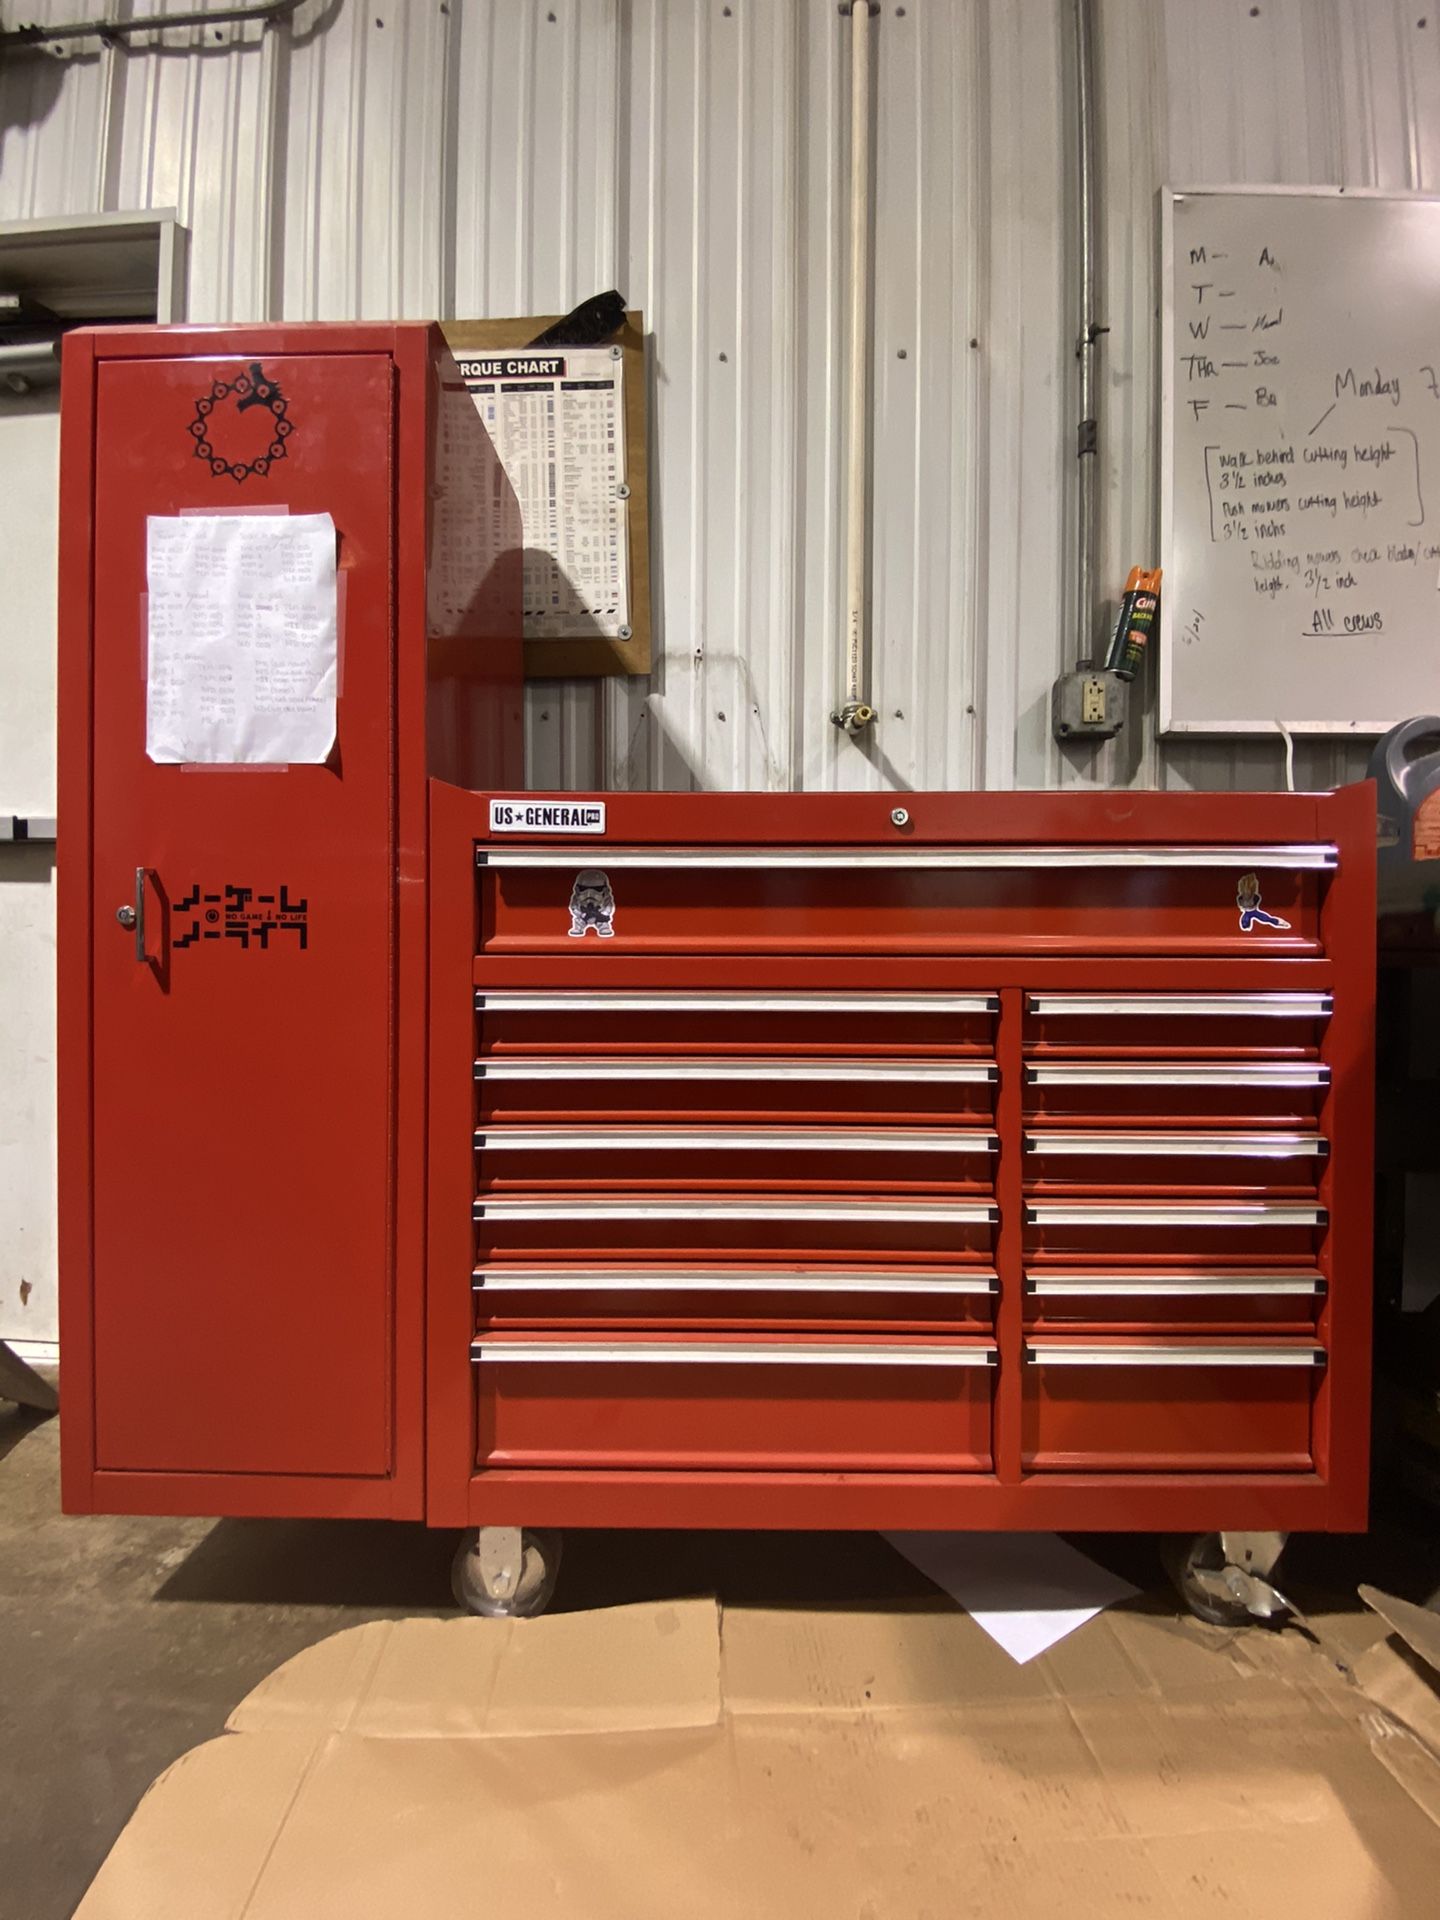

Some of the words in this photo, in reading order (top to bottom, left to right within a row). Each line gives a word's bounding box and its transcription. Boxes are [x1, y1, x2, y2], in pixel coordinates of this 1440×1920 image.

[458, 361, 502, 376] RQUE
[506, 360, 559, 374] CHART
[1335, 367, 1401, 407] Monday
[1354, 441, 1396, 470] height
[1342, 490, 1383, 517] height
[1311, 608, 1335, 632] All
[1344, 610, 1383, 633] crews
[494, 806, 513, 825] US
[525, 807, 588, 826] GENERAL
[290, 913, 307, 921] LIFE
